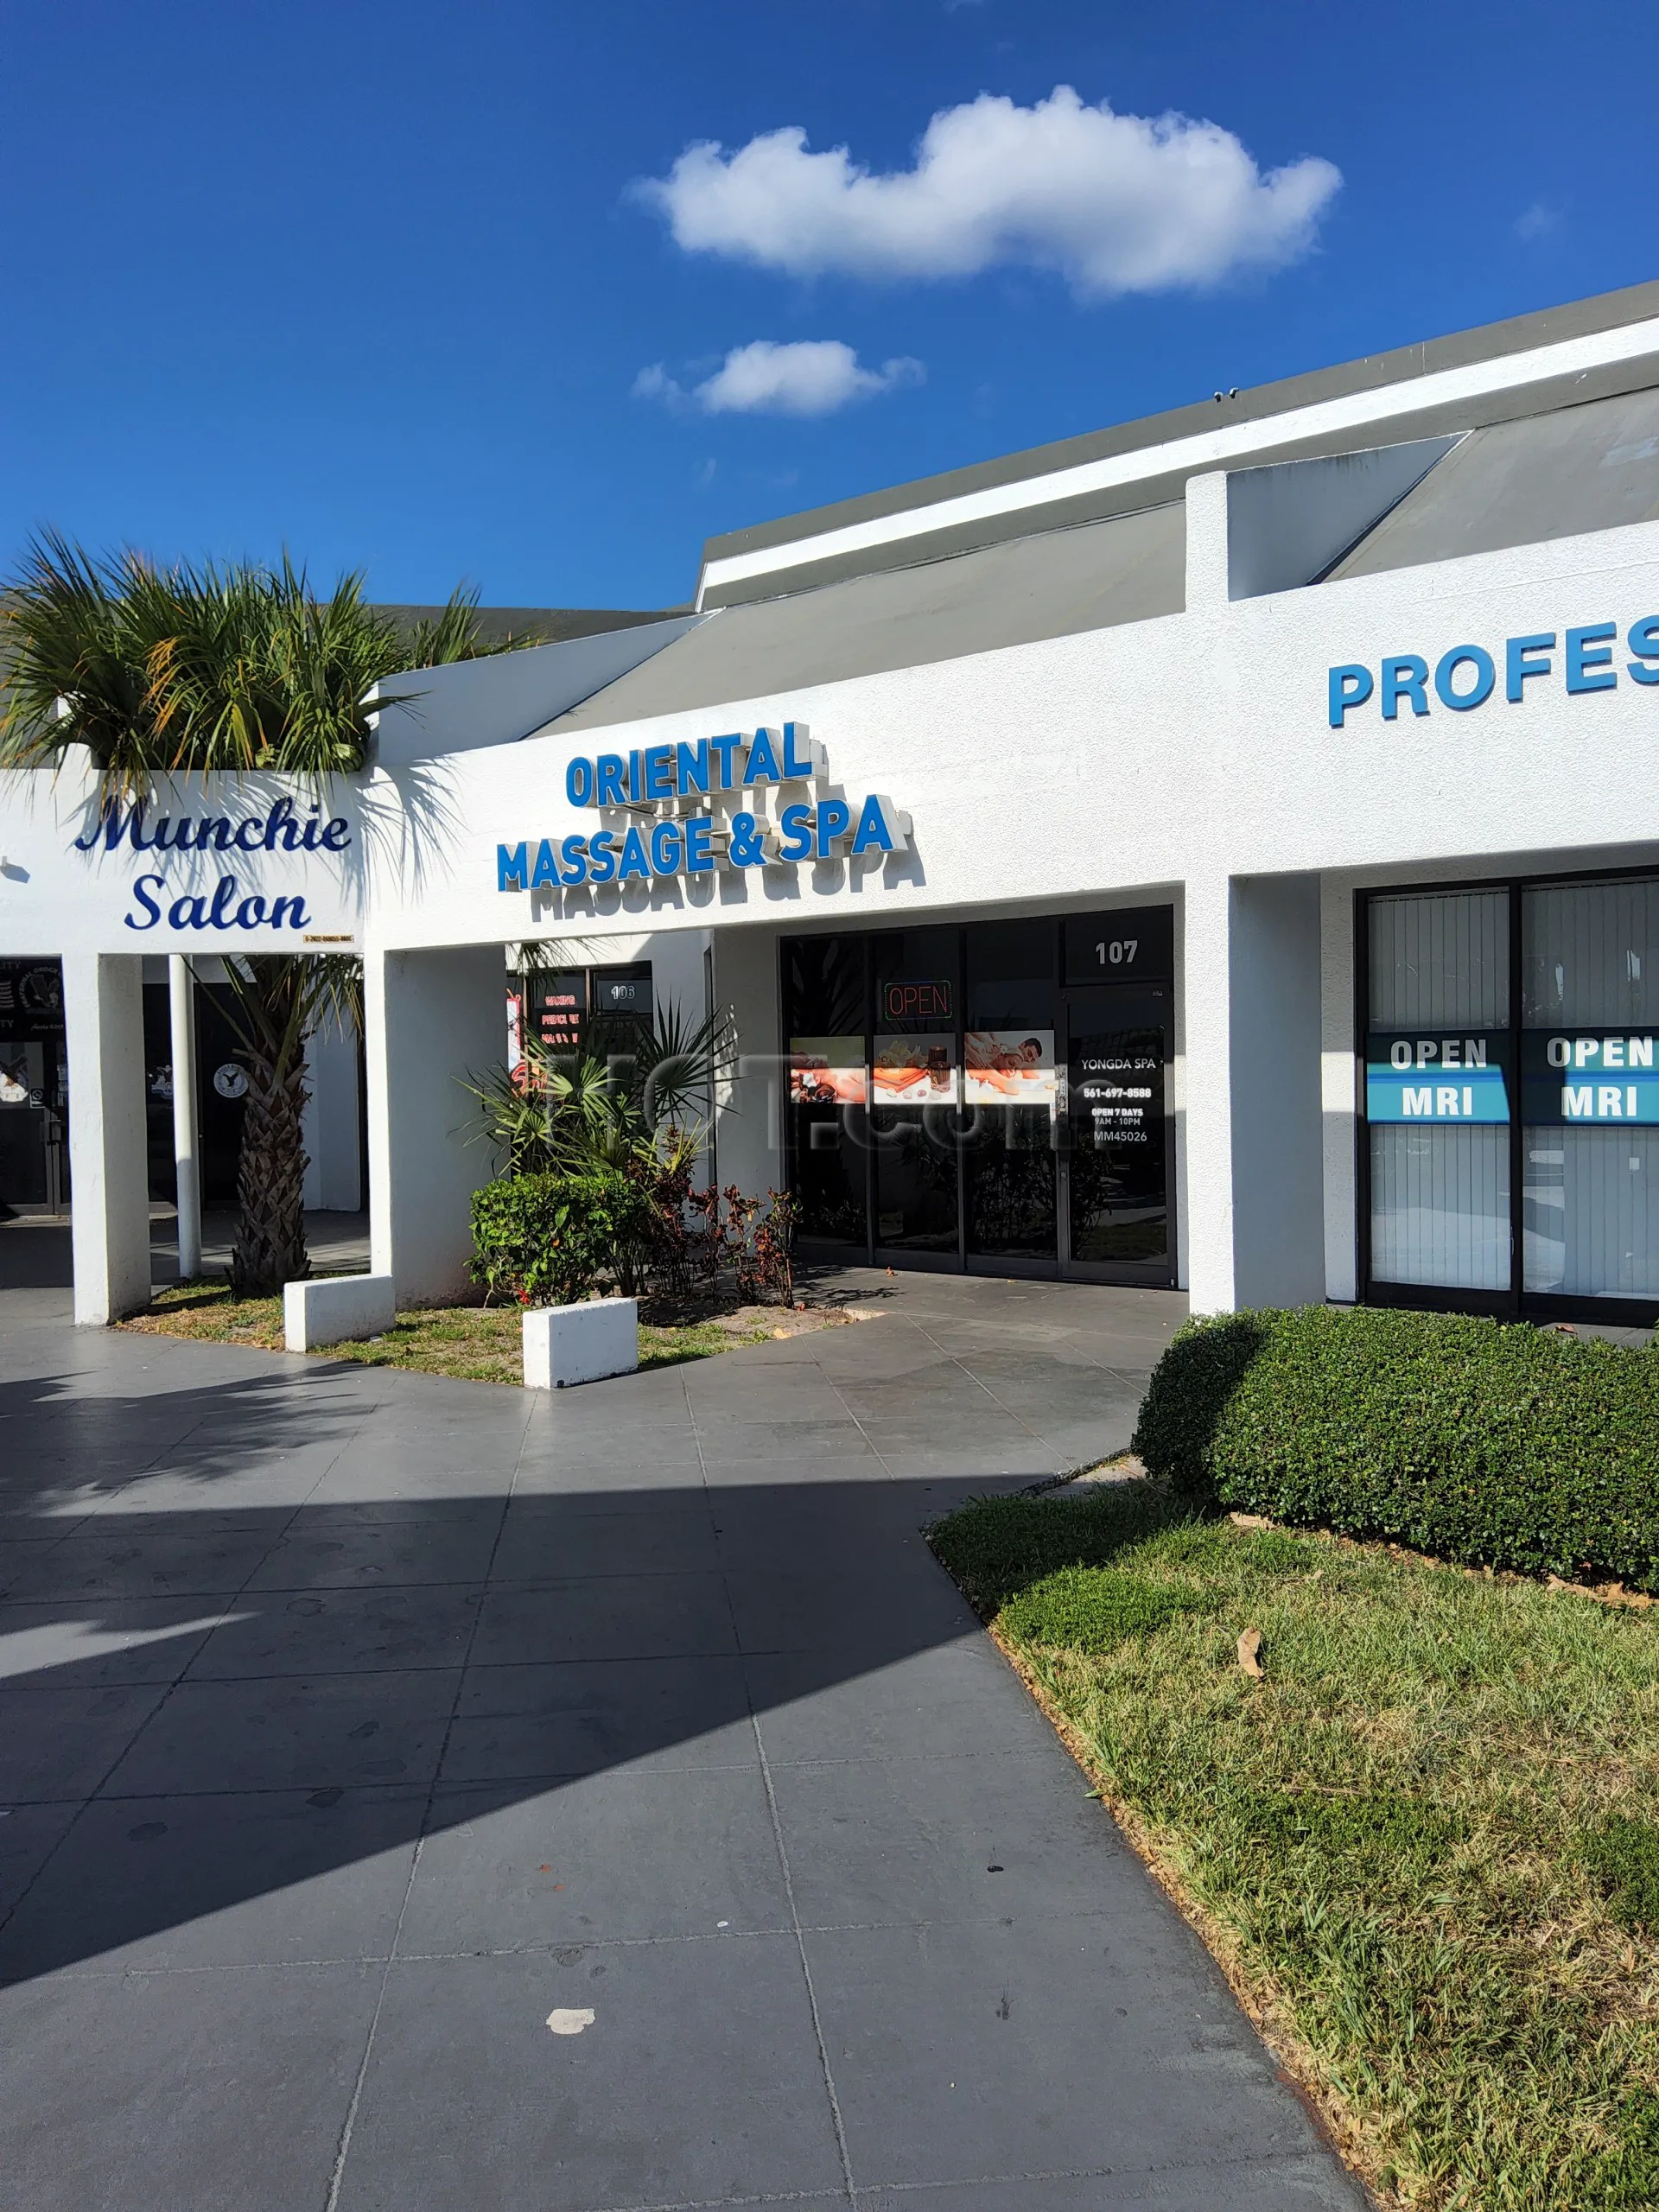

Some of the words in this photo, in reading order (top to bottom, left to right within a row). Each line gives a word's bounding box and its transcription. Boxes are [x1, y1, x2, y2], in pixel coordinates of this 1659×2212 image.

[1328, 614, 1659, 728] PROFES
[566, 721, 815, 808] ORIENTAL
[74, 795, 353, 851] Munchie
[497, 815, 716, 893] MASSAGE
[729, 810, 767, 868] &
[780, 793, 899, 862] SPA
[124, 874, 312, 930] Salon
[1096, 940, 1138, 964] 107
[611, 986, 635, 1000] 106
[889, 985, 948, 1014] OPEN
[1081, 1058, 1132, 1070] YONGDA
[1135, 1058, 1156, 1069] SPA
[1390, 1039, 1487, 1070] OPEN
[1547, 1036, 1653, 1068] OPEN
[1084, 1088, 1152, 1098] 561-697-8588
[1402, 1087, 1472, 1116] MRI
[1561, 1086, 1637, 1116] MRI
[1091, 1108, 1114, 1117] OPEN
[1115, 1108, 1121, 1116] 7
[1122, 1108, 1144, 1116] DAYS
[1119, 1117, 1141, 1126] 10PM
[1094, 1131, 1147, 1141] MM45026
